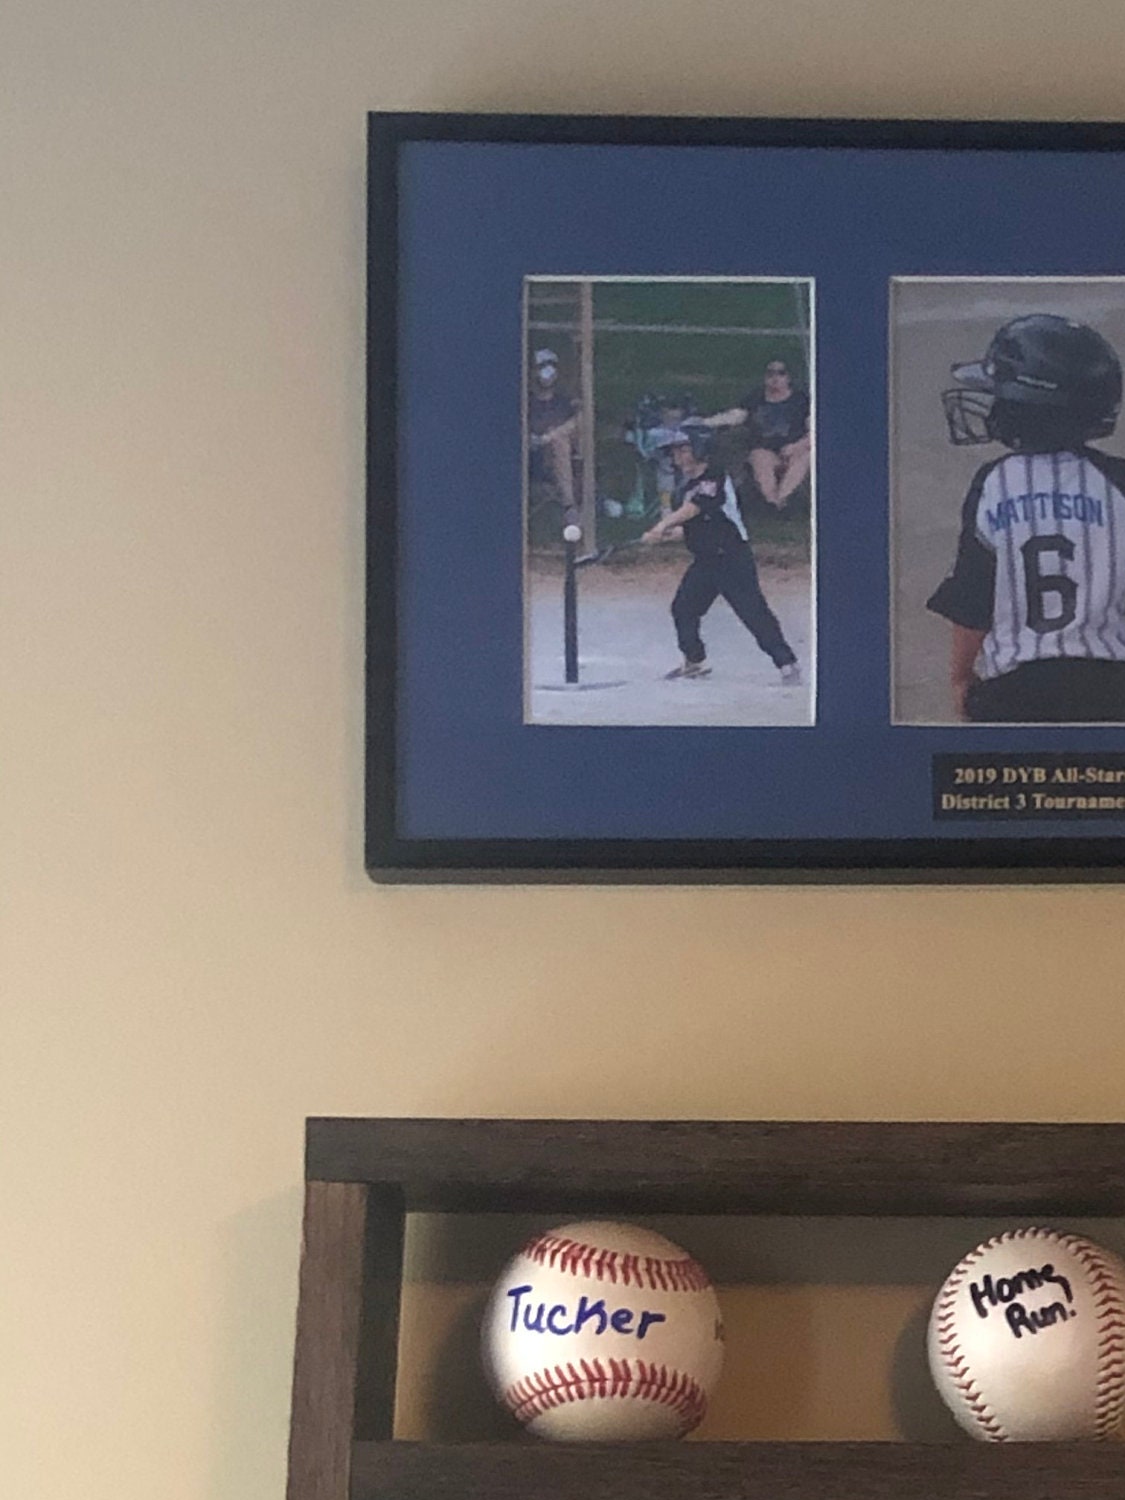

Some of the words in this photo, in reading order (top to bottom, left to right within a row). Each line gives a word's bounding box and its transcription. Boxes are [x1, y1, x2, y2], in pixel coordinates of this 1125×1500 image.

[985, 492, 1104, 532] MATTISON
[1020, 534, 1078, 634] 6
[954, 767, 997, 784] 2019
[1003, 767, 1046, 784] DYB
[941, 794, 1011, 810] District
[1015, 794, 1027, 810] 3
[507, 1285, 666, 1339] Tucker
